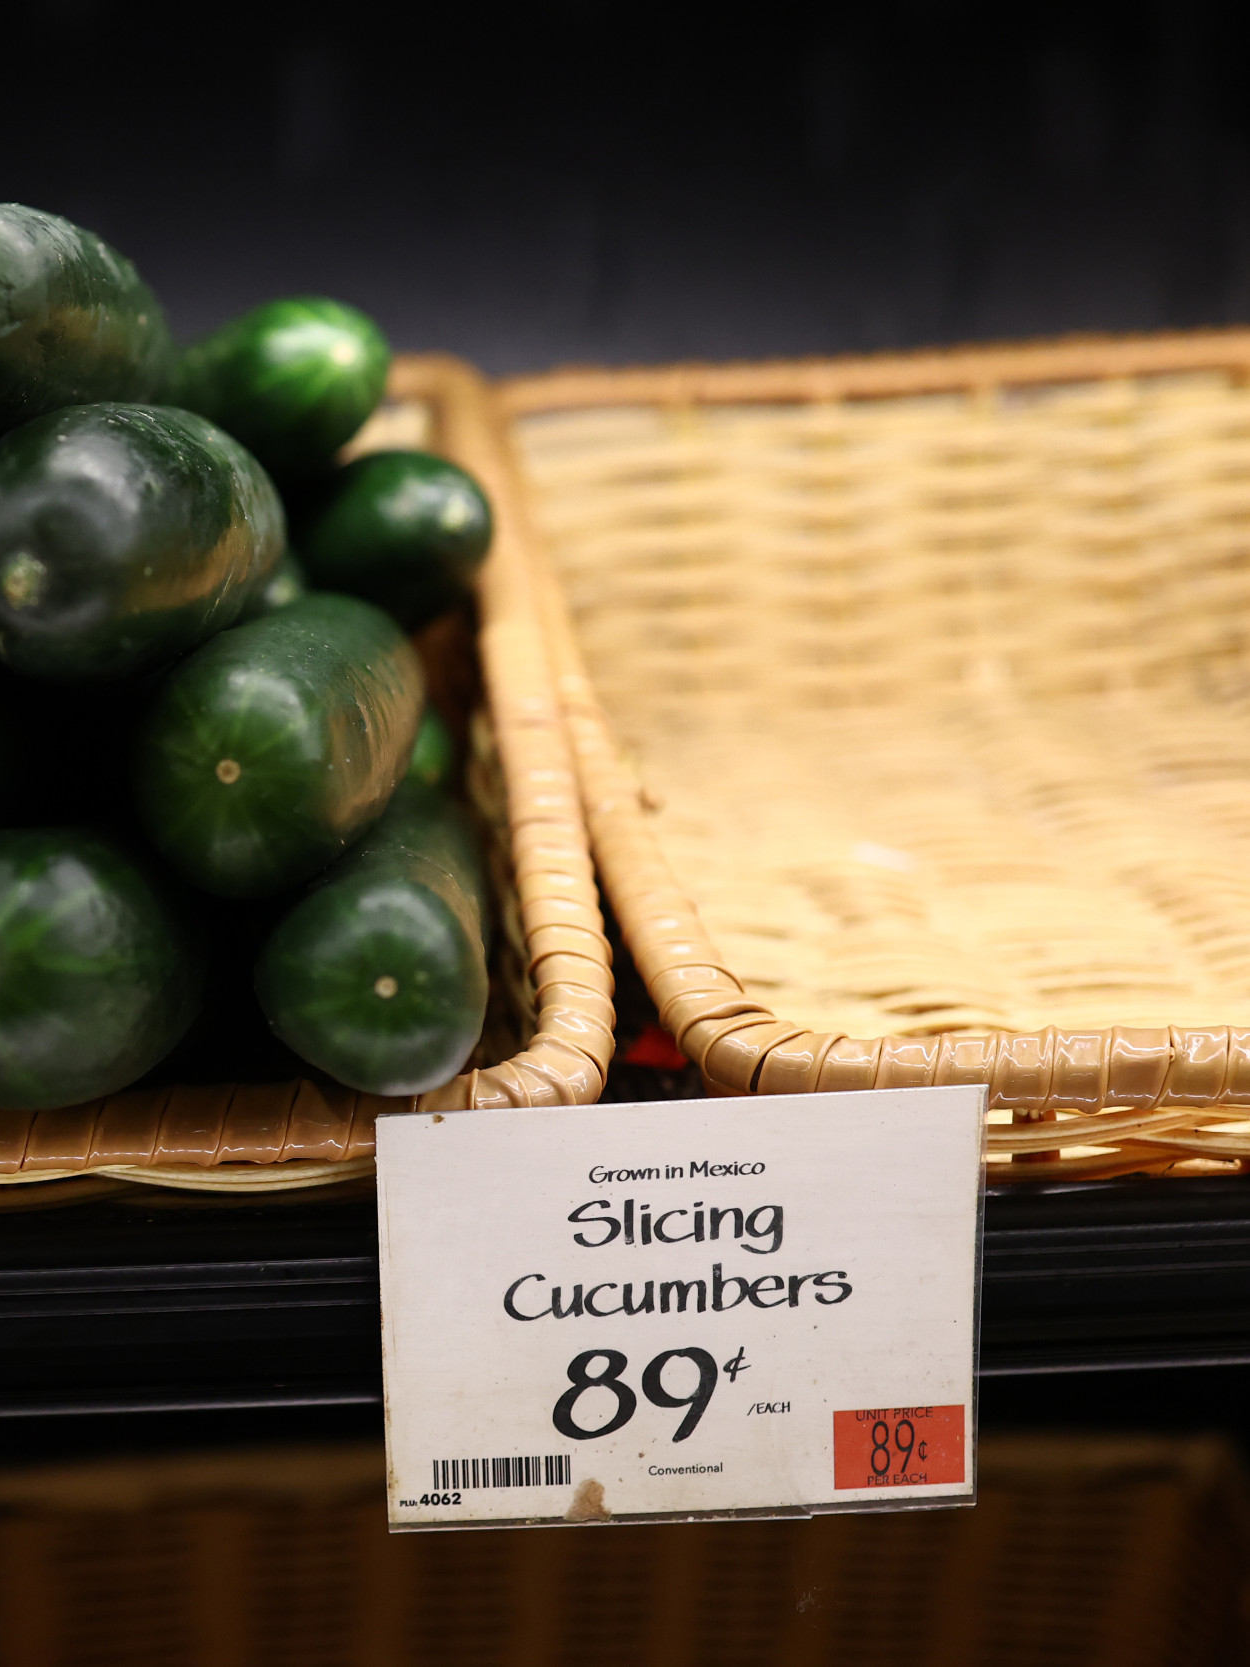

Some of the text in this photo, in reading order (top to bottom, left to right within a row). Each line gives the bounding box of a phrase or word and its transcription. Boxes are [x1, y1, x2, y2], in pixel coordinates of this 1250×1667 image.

[588, 1159, 766, 1184] Grown in Mexico
[567, 1199, 784, 1254] Slicing
[503, 1263, 853, 1322] Cucumbers
[747, 1401, 792, 1417] /EACH
[855, 1407, 933, 1421] UNIT PRICE
[648, 1462, 724, 1477] Conventional
[867, 1473, 928, 1486] PER EACH
[399, 1492, 462, 1508] PLU: 4062
